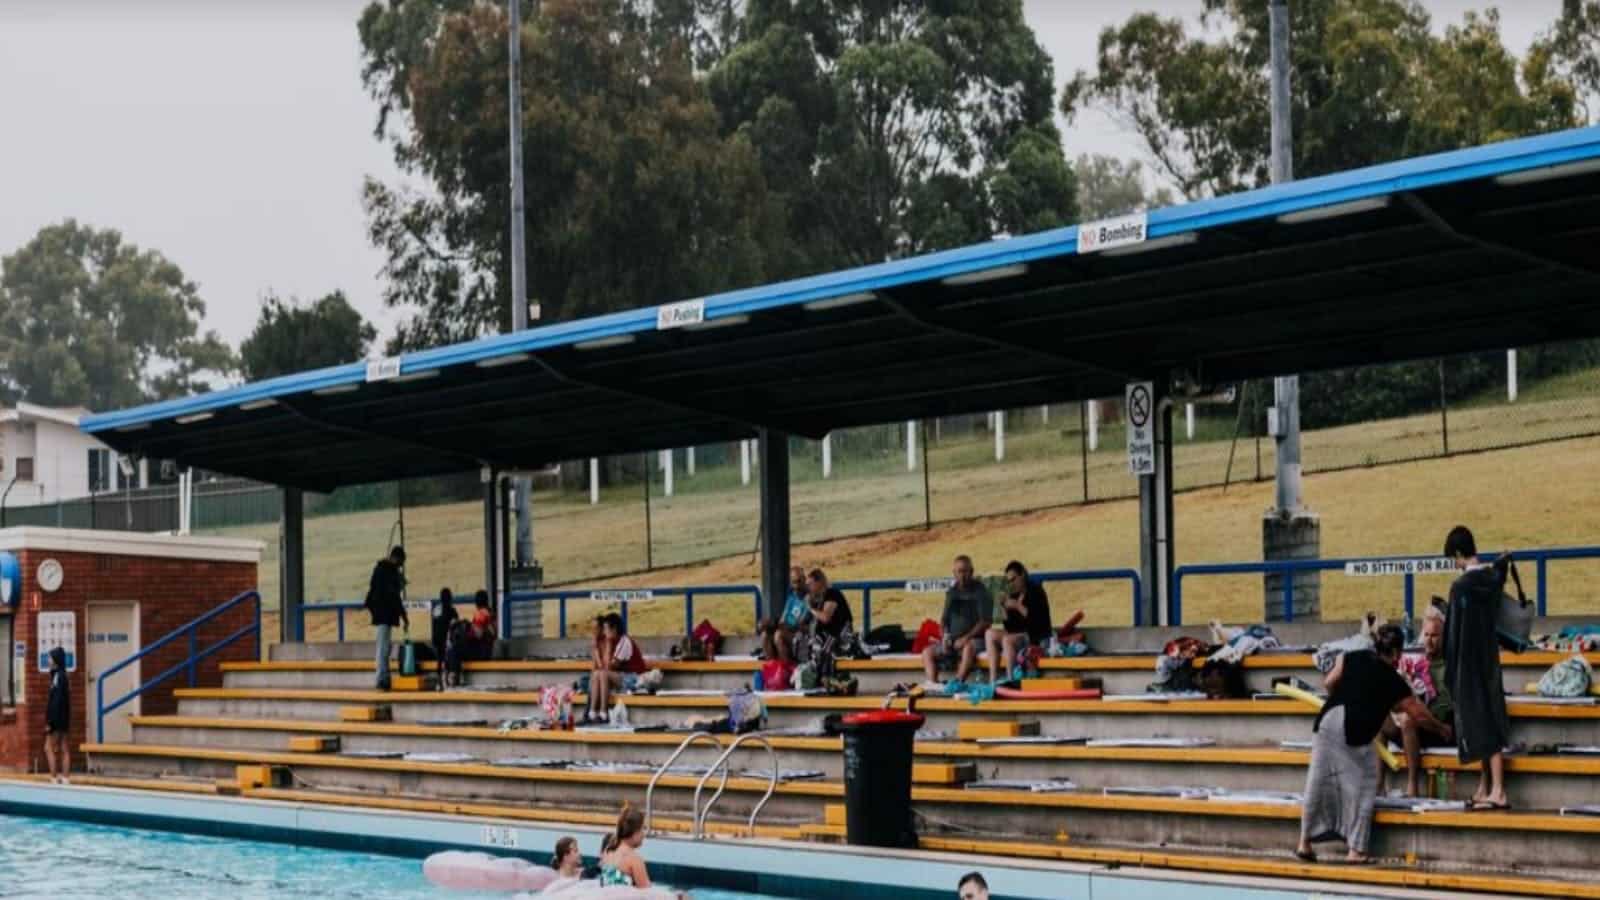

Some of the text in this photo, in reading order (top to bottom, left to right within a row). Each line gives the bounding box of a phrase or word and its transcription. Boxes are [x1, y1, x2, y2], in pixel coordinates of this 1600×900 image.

[1081, 223, 1143, 248] NO Bombing
[1135, 429, 1145, 440] No
[1129, 443, 1152, 456] Diving
[1354, 563, 1369, 575] NO
[1371, 560, 1414, 574] SITTING
[1417, 559, 1432, 571] ON
